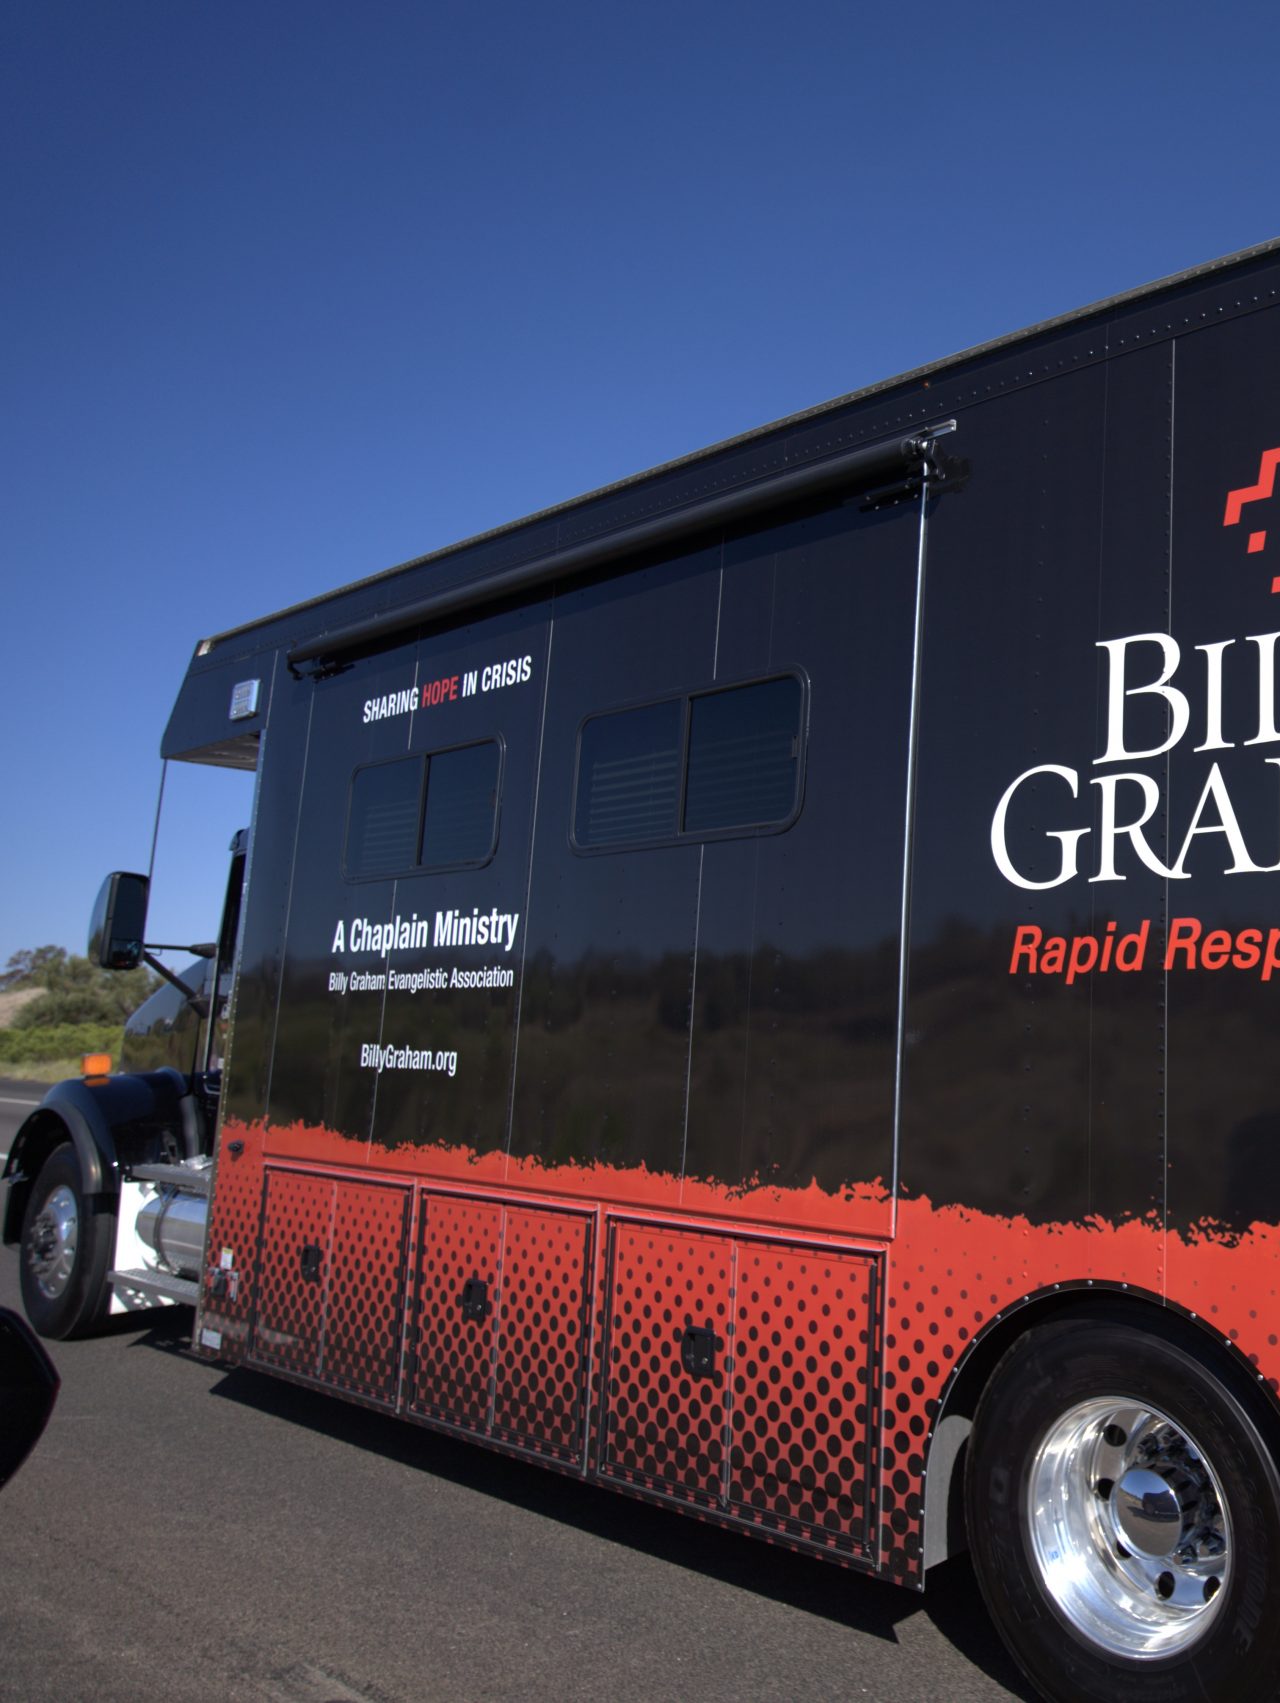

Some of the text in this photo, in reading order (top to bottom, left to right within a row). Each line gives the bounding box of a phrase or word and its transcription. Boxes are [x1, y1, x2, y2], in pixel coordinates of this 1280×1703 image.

[363, 655, 532, 724] SHARING HOPE IN CRISIS
[332, 908, 519, 958] A Chaplain Ministry
[1009, 919, 1150, 985] Rapid
[328, 966, 514, 995] Billy Graham Evangelistic Association
[360, 1043, 457, 1077] BillyGraham.org
